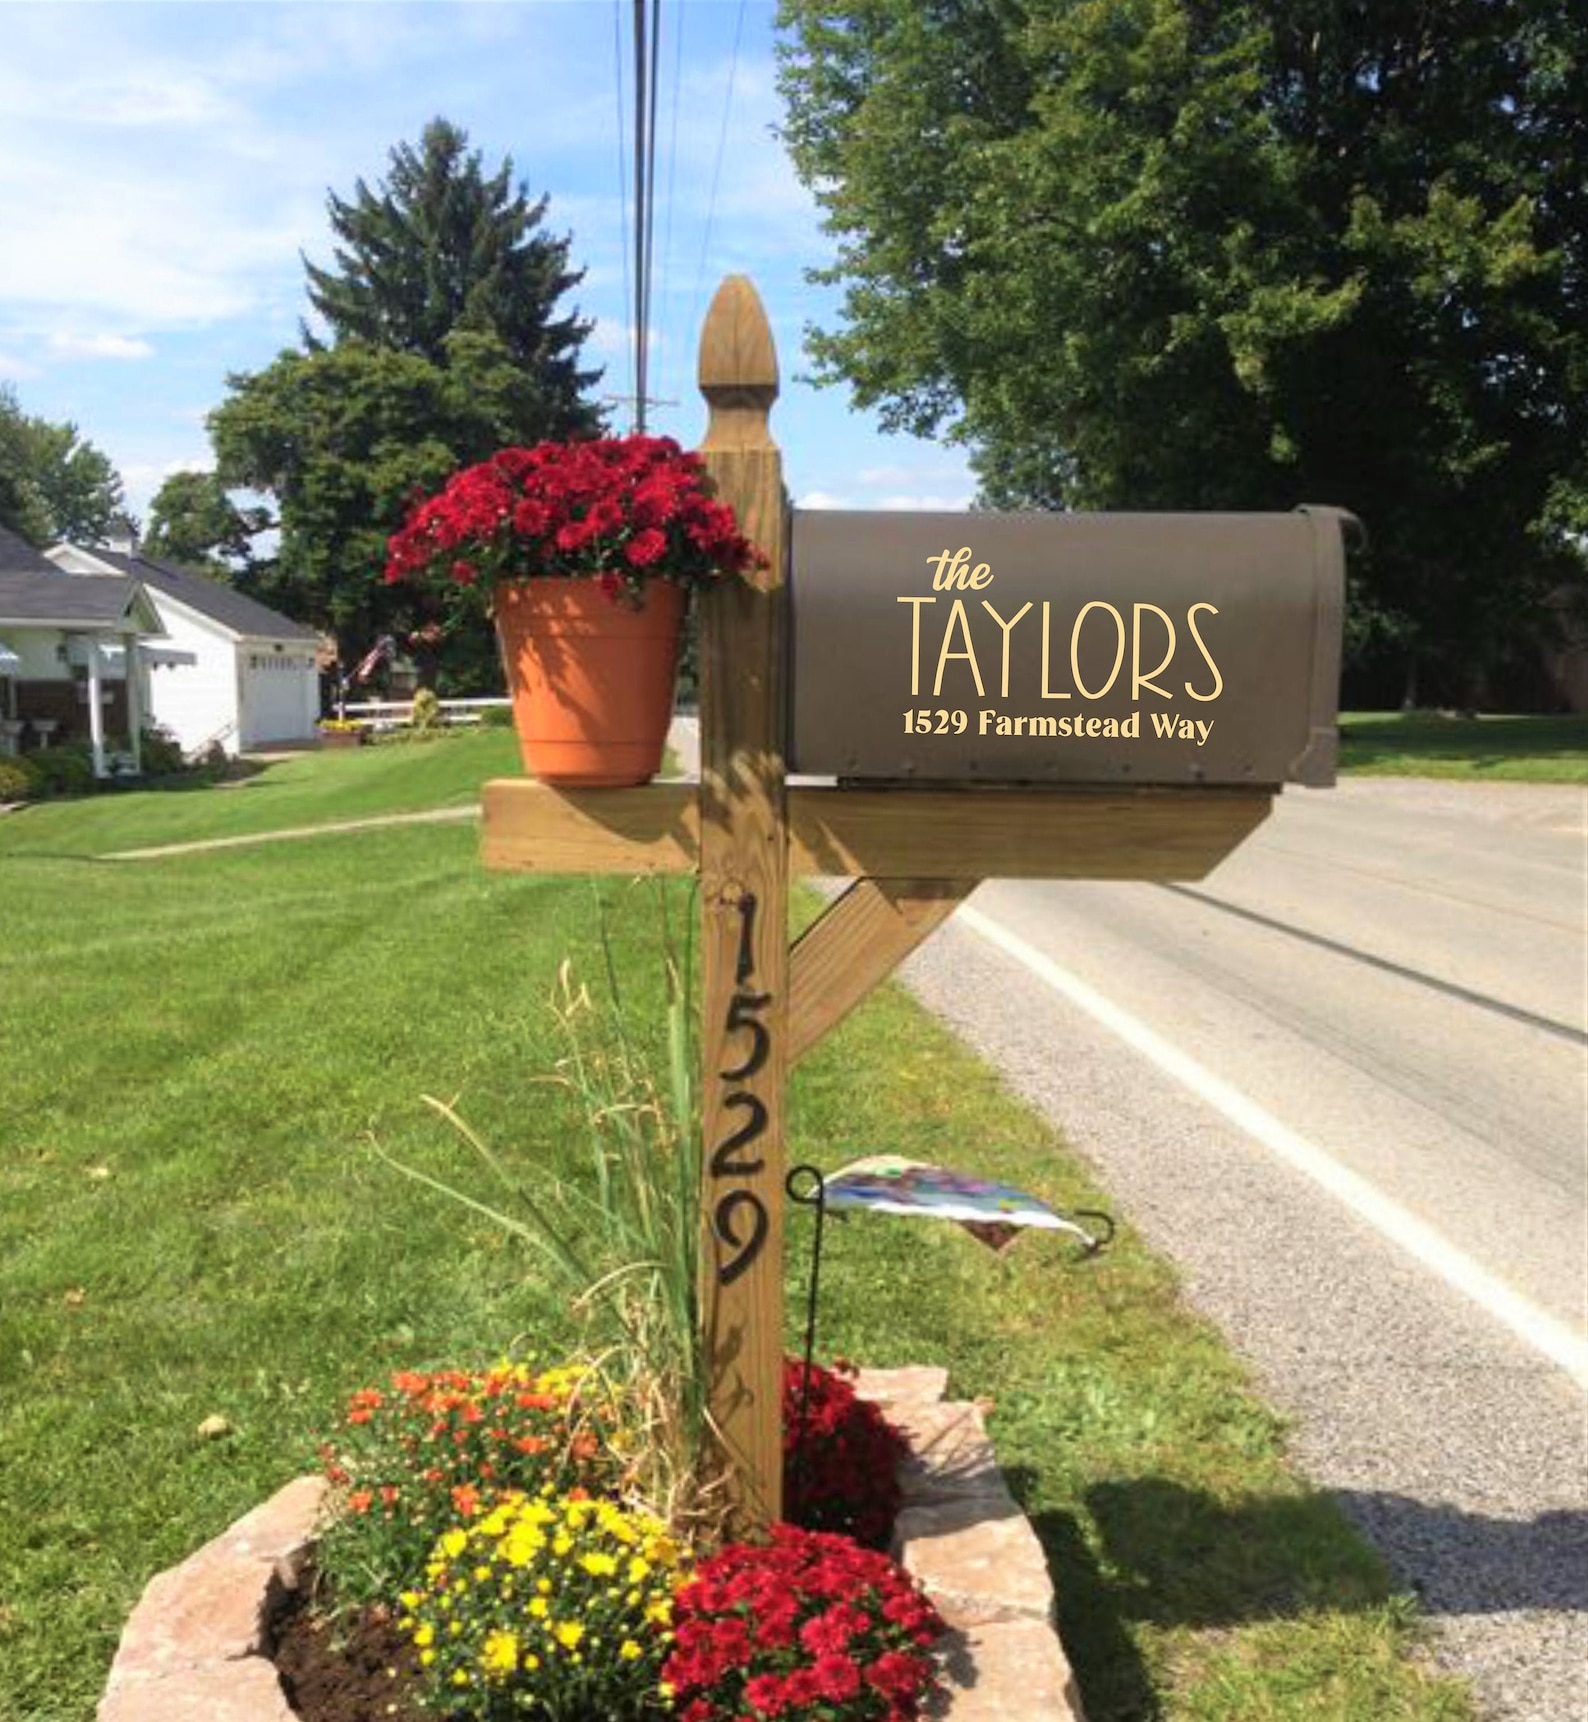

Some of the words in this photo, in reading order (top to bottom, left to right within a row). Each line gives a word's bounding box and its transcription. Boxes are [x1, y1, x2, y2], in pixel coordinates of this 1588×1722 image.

[926, 546, 995, 592] the
[896, 596, 1224, 702] TAYLORS
[902, 708, 968, 735] 1529
[978, 709, 1140, 738] Farmstead
[1150, 713, 1215, 747] Way
[710, 892, 772, 1286] 1529
